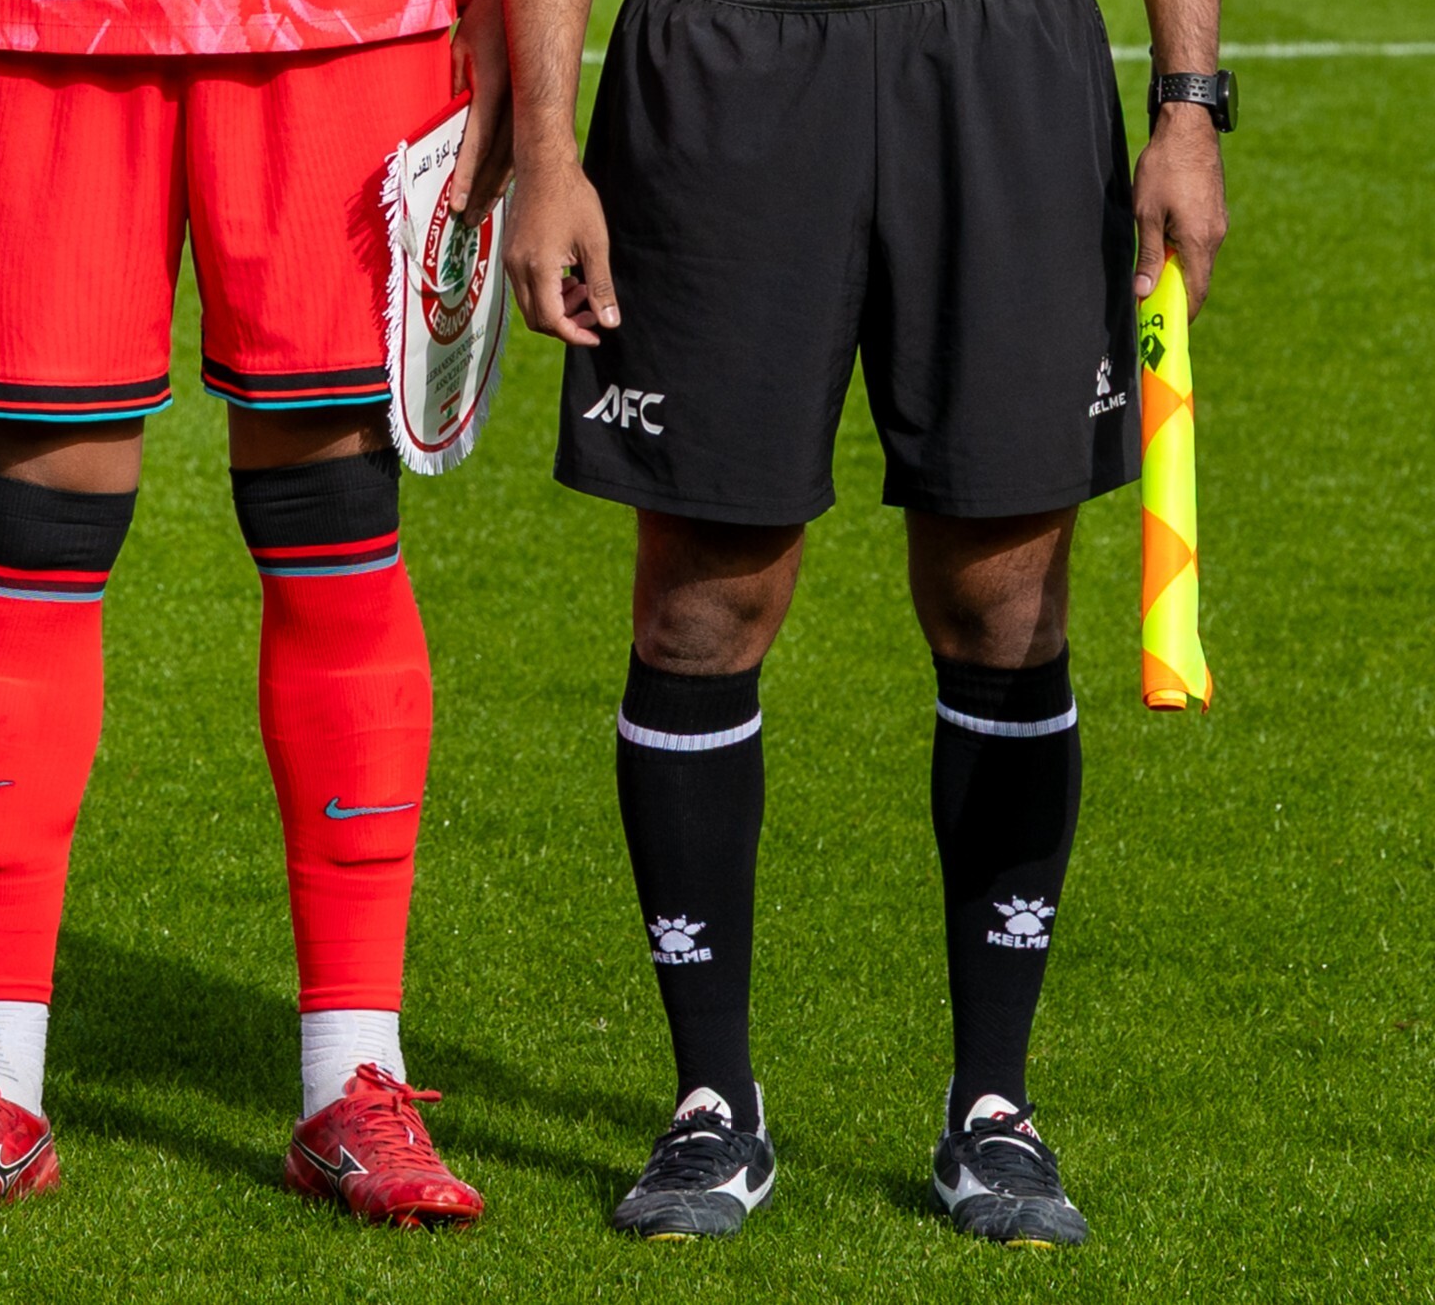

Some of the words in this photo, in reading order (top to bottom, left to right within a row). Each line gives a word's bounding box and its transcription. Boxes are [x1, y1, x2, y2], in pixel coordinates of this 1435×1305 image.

[428, 294, 474, 337] LEBANON
[583, 384, 665, 435] AFC
[1089, 392, 1127, 418] KELME
[653, 947, 713, 965] KELME
